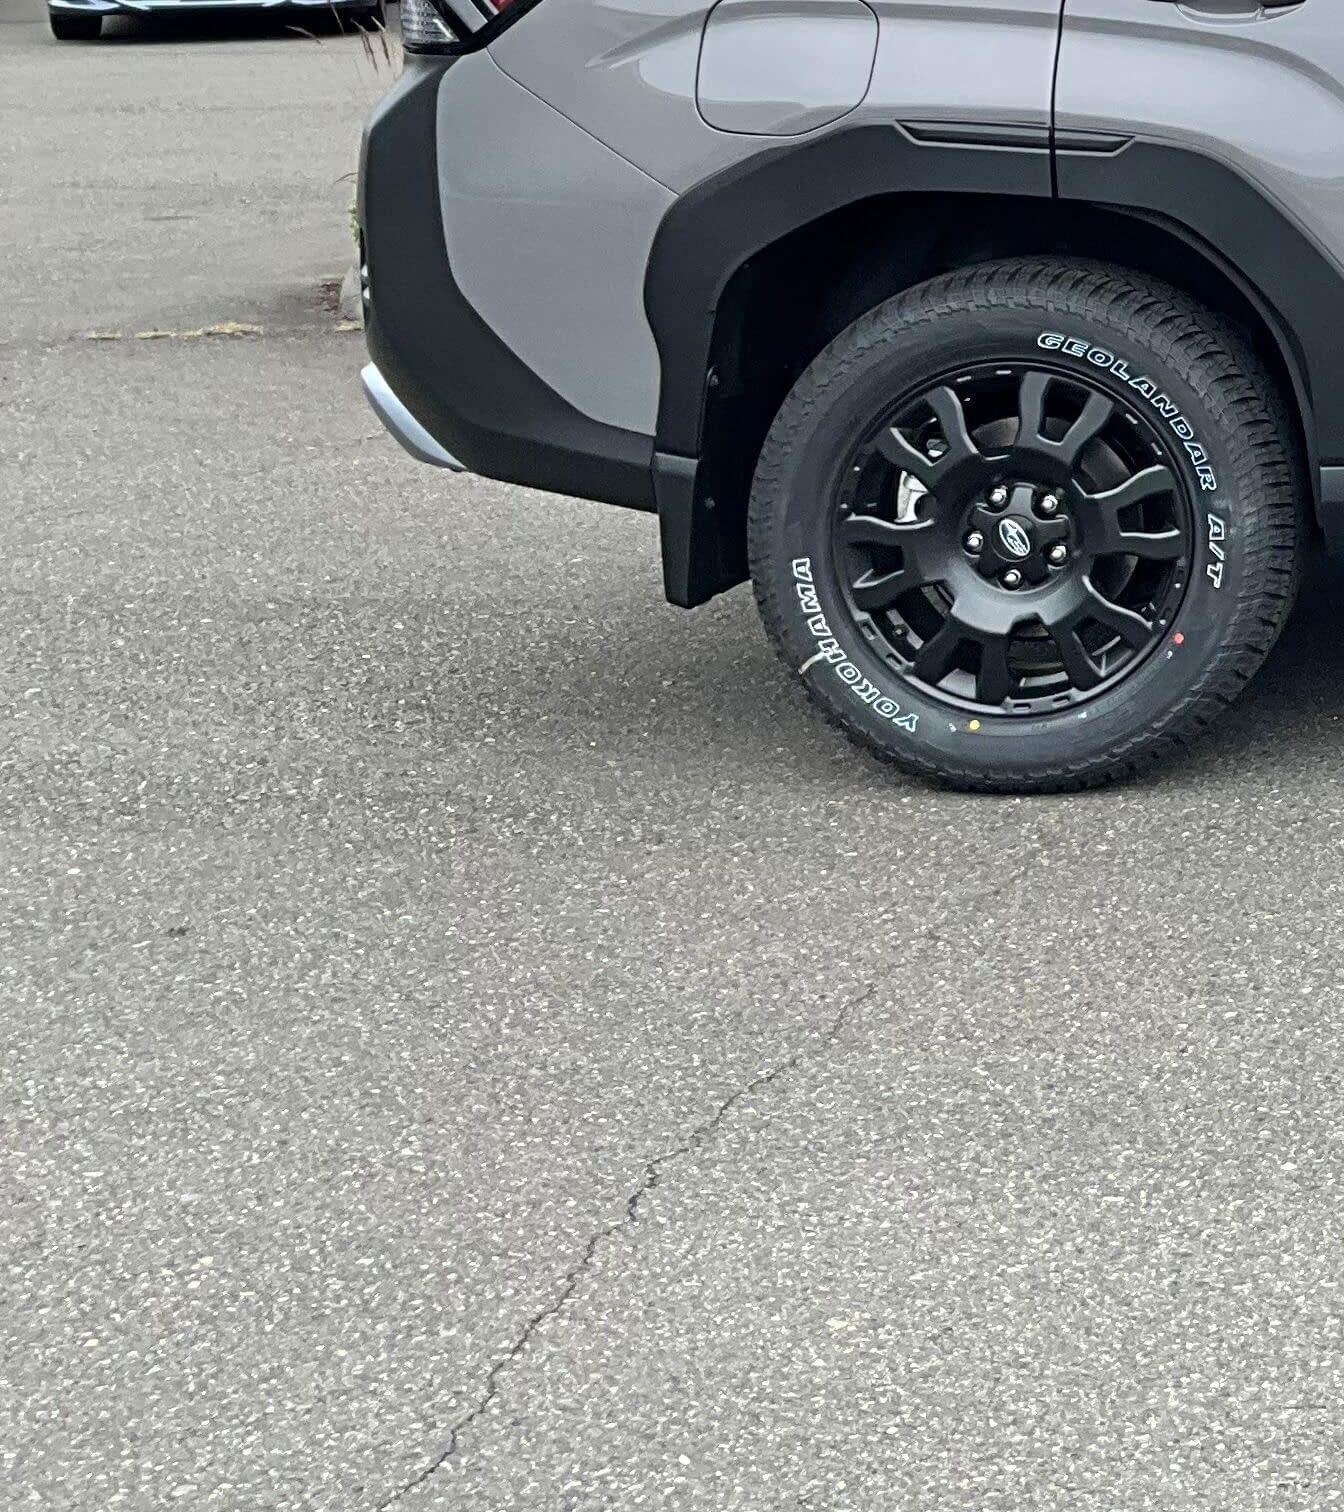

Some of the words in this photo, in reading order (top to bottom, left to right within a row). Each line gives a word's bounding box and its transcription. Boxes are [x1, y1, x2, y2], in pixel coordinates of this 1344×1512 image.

[1037, 331, 1217, 492] GEOLANDAR
[1207, 513, 1226, 588] A/T
[792, 557, 920, 733] YOKOHAMA
